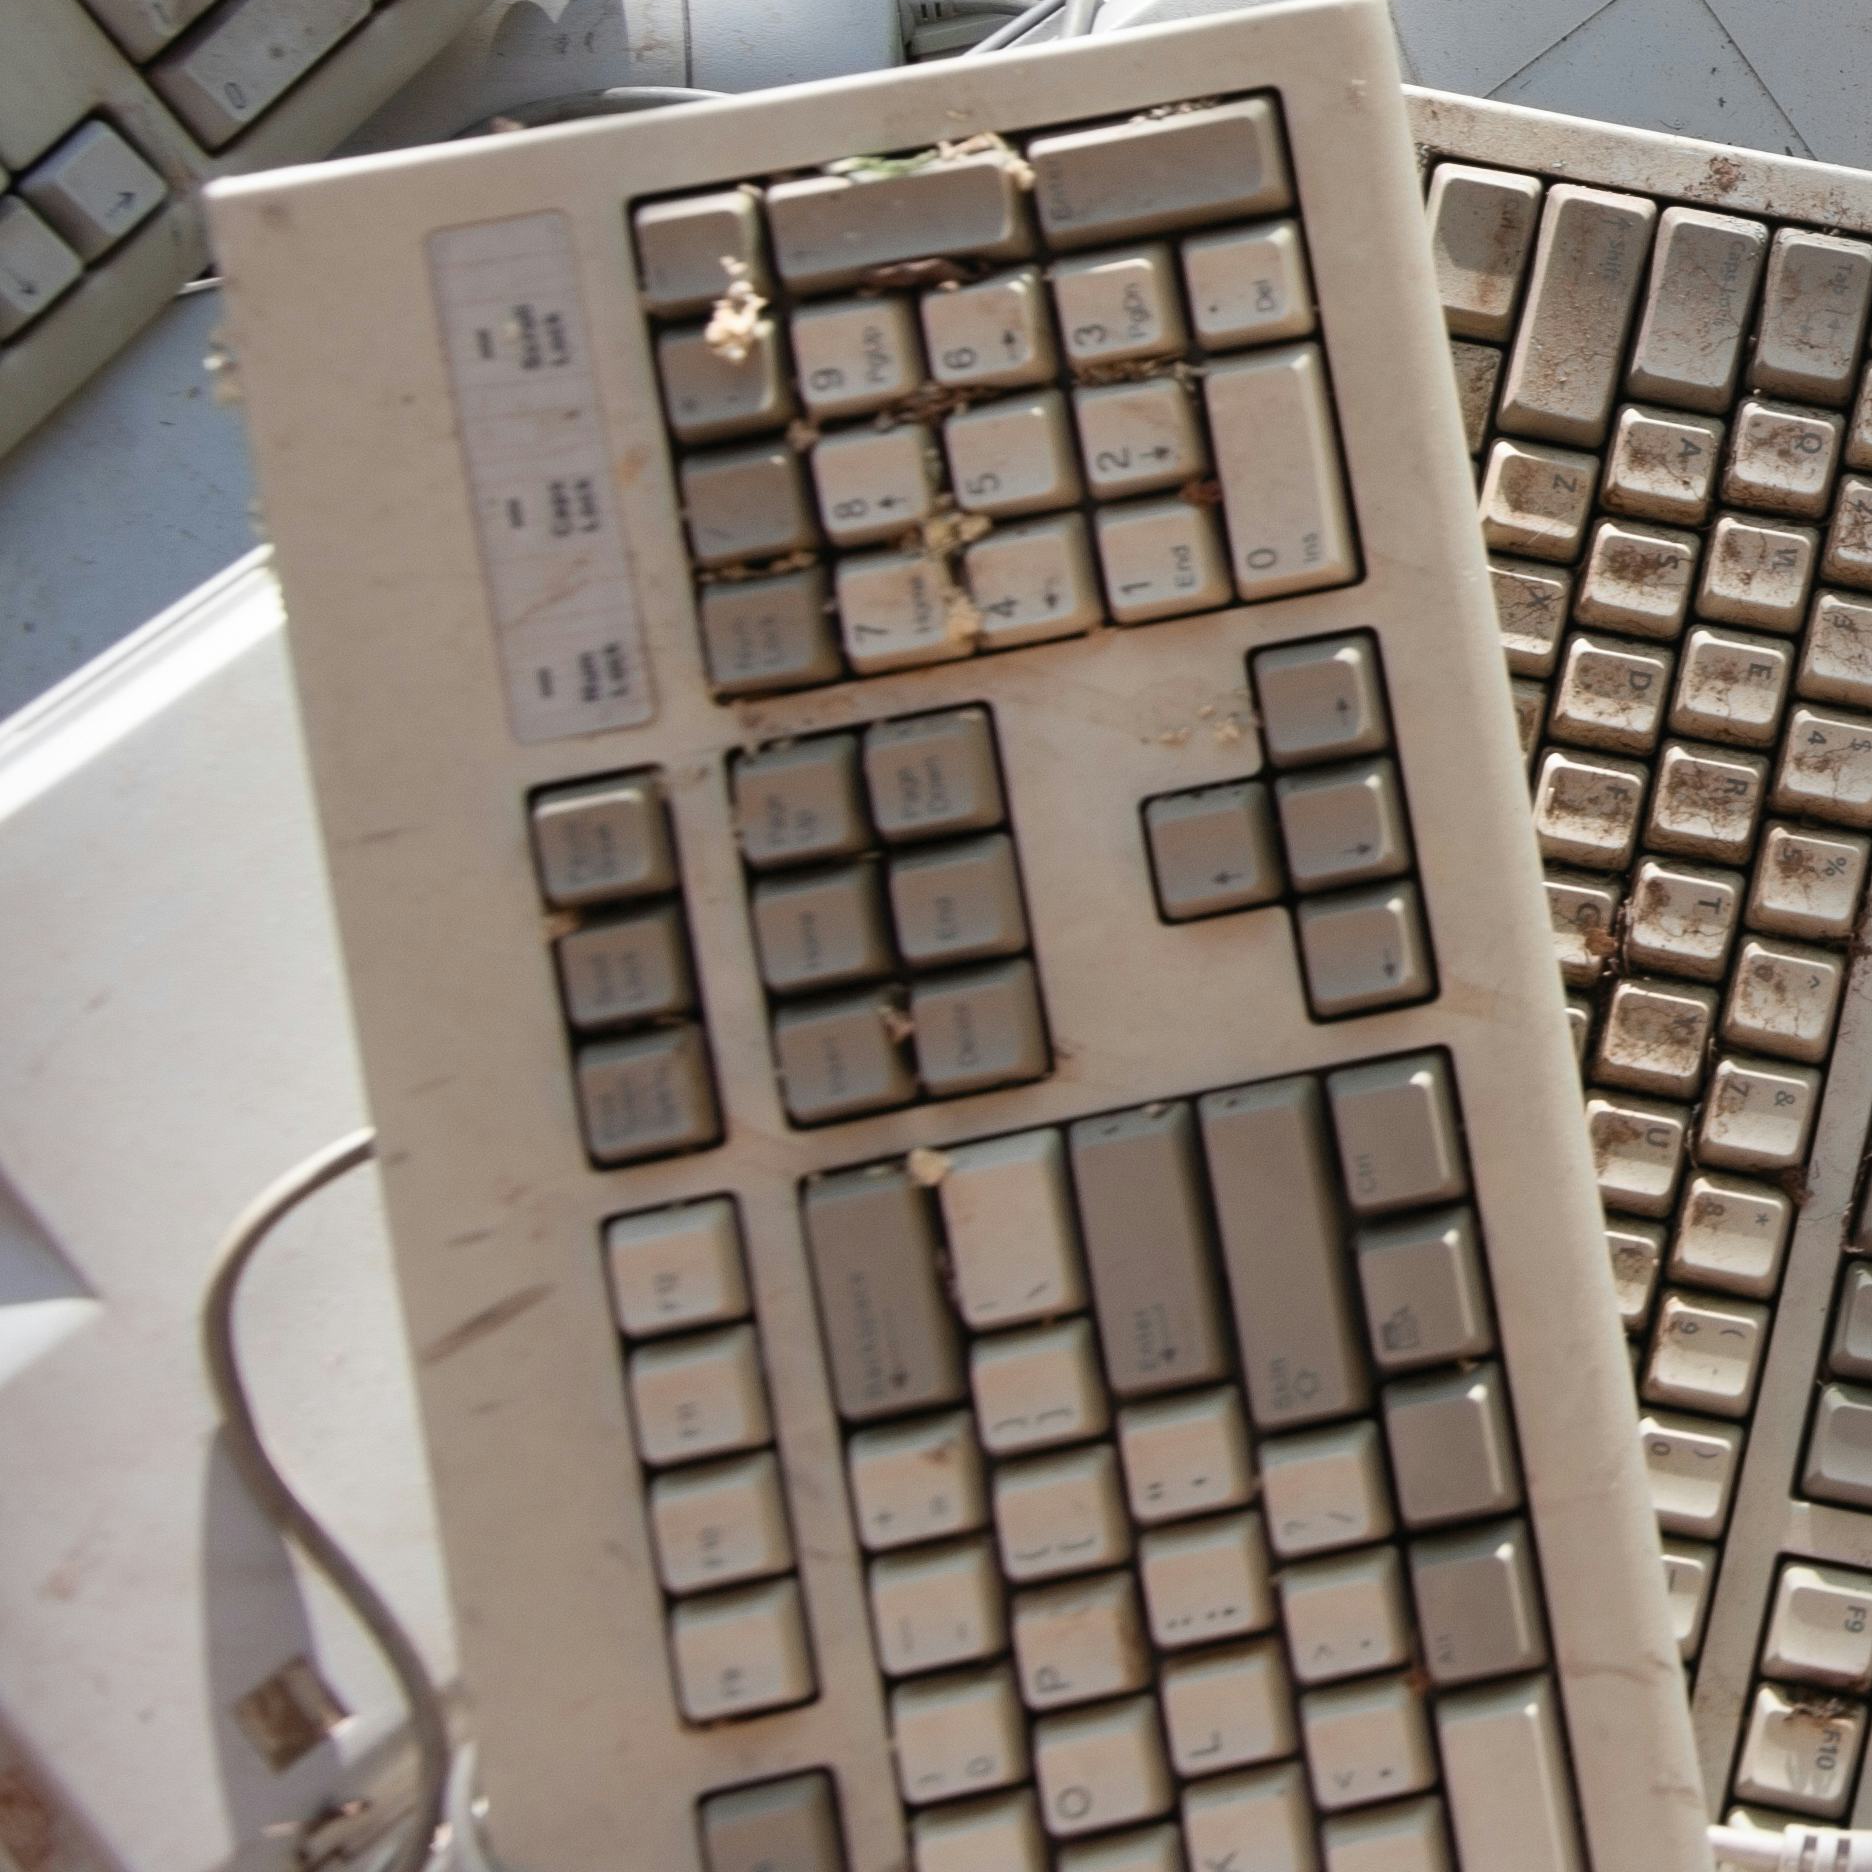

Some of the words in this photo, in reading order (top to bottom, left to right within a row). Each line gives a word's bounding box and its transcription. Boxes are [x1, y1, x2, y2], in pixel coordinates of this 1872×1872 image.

[1257, 279, 1276, 314] Del
[1126, 281, 1149, 338] PgDn
[1075, 323, 1107, 347] 3
[943, 347, 976, 371] 6
[1679, 438, 1700, 459] A
[1097, 449, 1131, 473] 2
[965, 473, 998, 499] 5
[834, 496, 867, 520] 8
[1174, 544, 1196, 588] End
[1246, 548, 1278, 570] 0
[1530, 592, 1552, 612] X
[1629, 671, 1652, 692] D
[1725, 776, 1748, 799] R
[1844, 1604, 1865, 1633] F9
